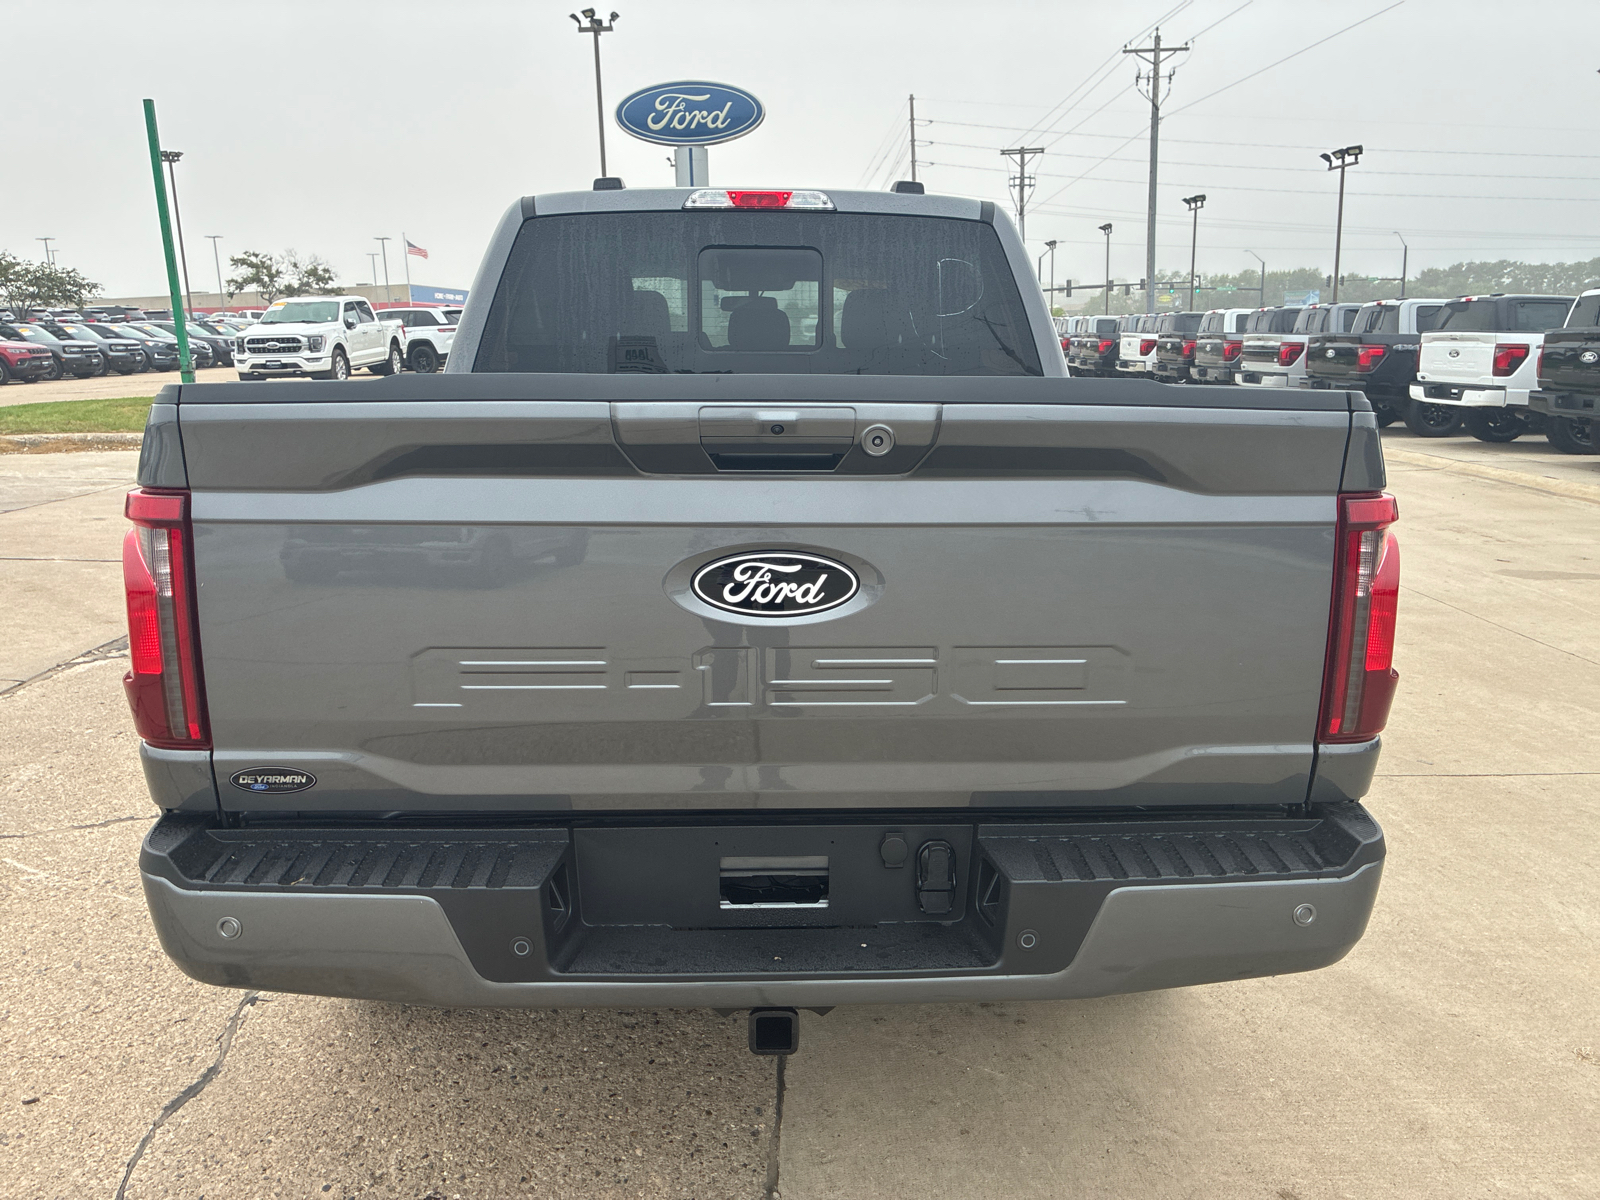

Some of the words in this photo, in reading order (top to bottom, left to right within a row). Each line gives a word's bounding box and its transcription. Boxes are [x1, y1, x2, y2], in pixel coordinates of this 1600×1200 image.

[647, 94, 732, 130] Ford
[723, 562, 828, 604] Ford
[410, 645, 1134, 706] F-150
[239, 775, 306, 783] DEYARMAN
